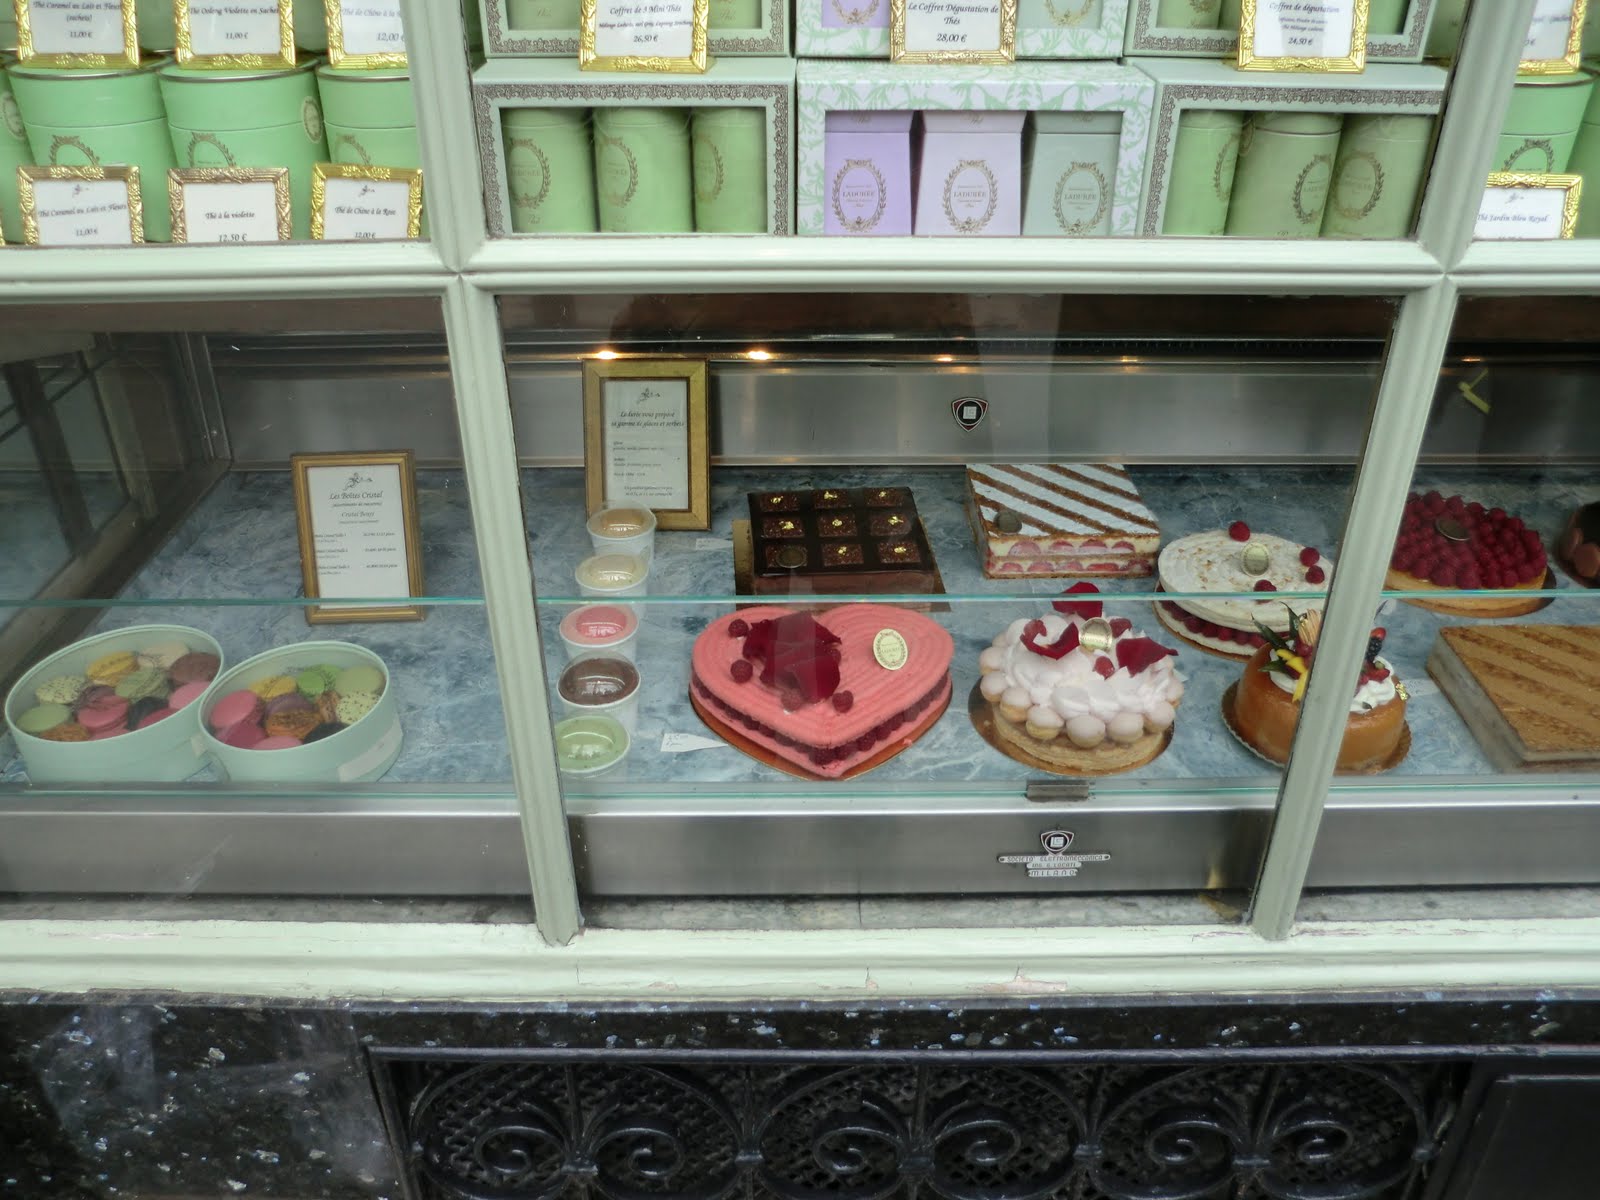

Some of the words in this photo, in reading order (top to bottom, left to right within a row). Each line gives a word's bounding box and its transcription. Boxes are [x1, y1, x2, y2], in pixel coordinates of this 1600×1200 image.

[224, 6, 249, 14] Violette
[610, 6, 633, 18] Coffret
[634, 5, 642, 14] de
[649, 4, 665, 13] Mini
[666, 4, 681, 12] Thés
[918, 3, 944, 14] Coffret
[945, 3, 989, 15] Dégustation
[990, 5, 999, 13] de
[1269, 2, 1293, 12] Coffret
[1294, 3, 1301, 11] de
[1302, 3, 1340, 14] dégustation
[944, 16, 961, 25] Thés
[88, 31, 93, 39] €
[225, 32, 243, 40] 11,00
[244, 32, 249, 40] €
[377, 32, 399, 42] 12,00
[633, 35, 653, 43] 26,50
[653, 34, 659, 42] €
[936, 33, 959, 43] 28,00
[960, 33, 967, 43] €
[1288, 37, 1307, 46] 24,50
[1307, 38, 1313, 46] €
[223, 211, 230, 219] la
[231, 210, 255, 218] violette
[335, 206, 345, 214] Thé
[346, 206, 353, 214] de
[1489, 214, 1510, 222] Jardin
[1528, 214, 1549, 224] Royal
[241, 233, 248, 242] €
[341, 491, 361, 500] Boîtes
[361, 490, 384, 499] Cristal
[1031, 869, 1075, 877] MILANO
